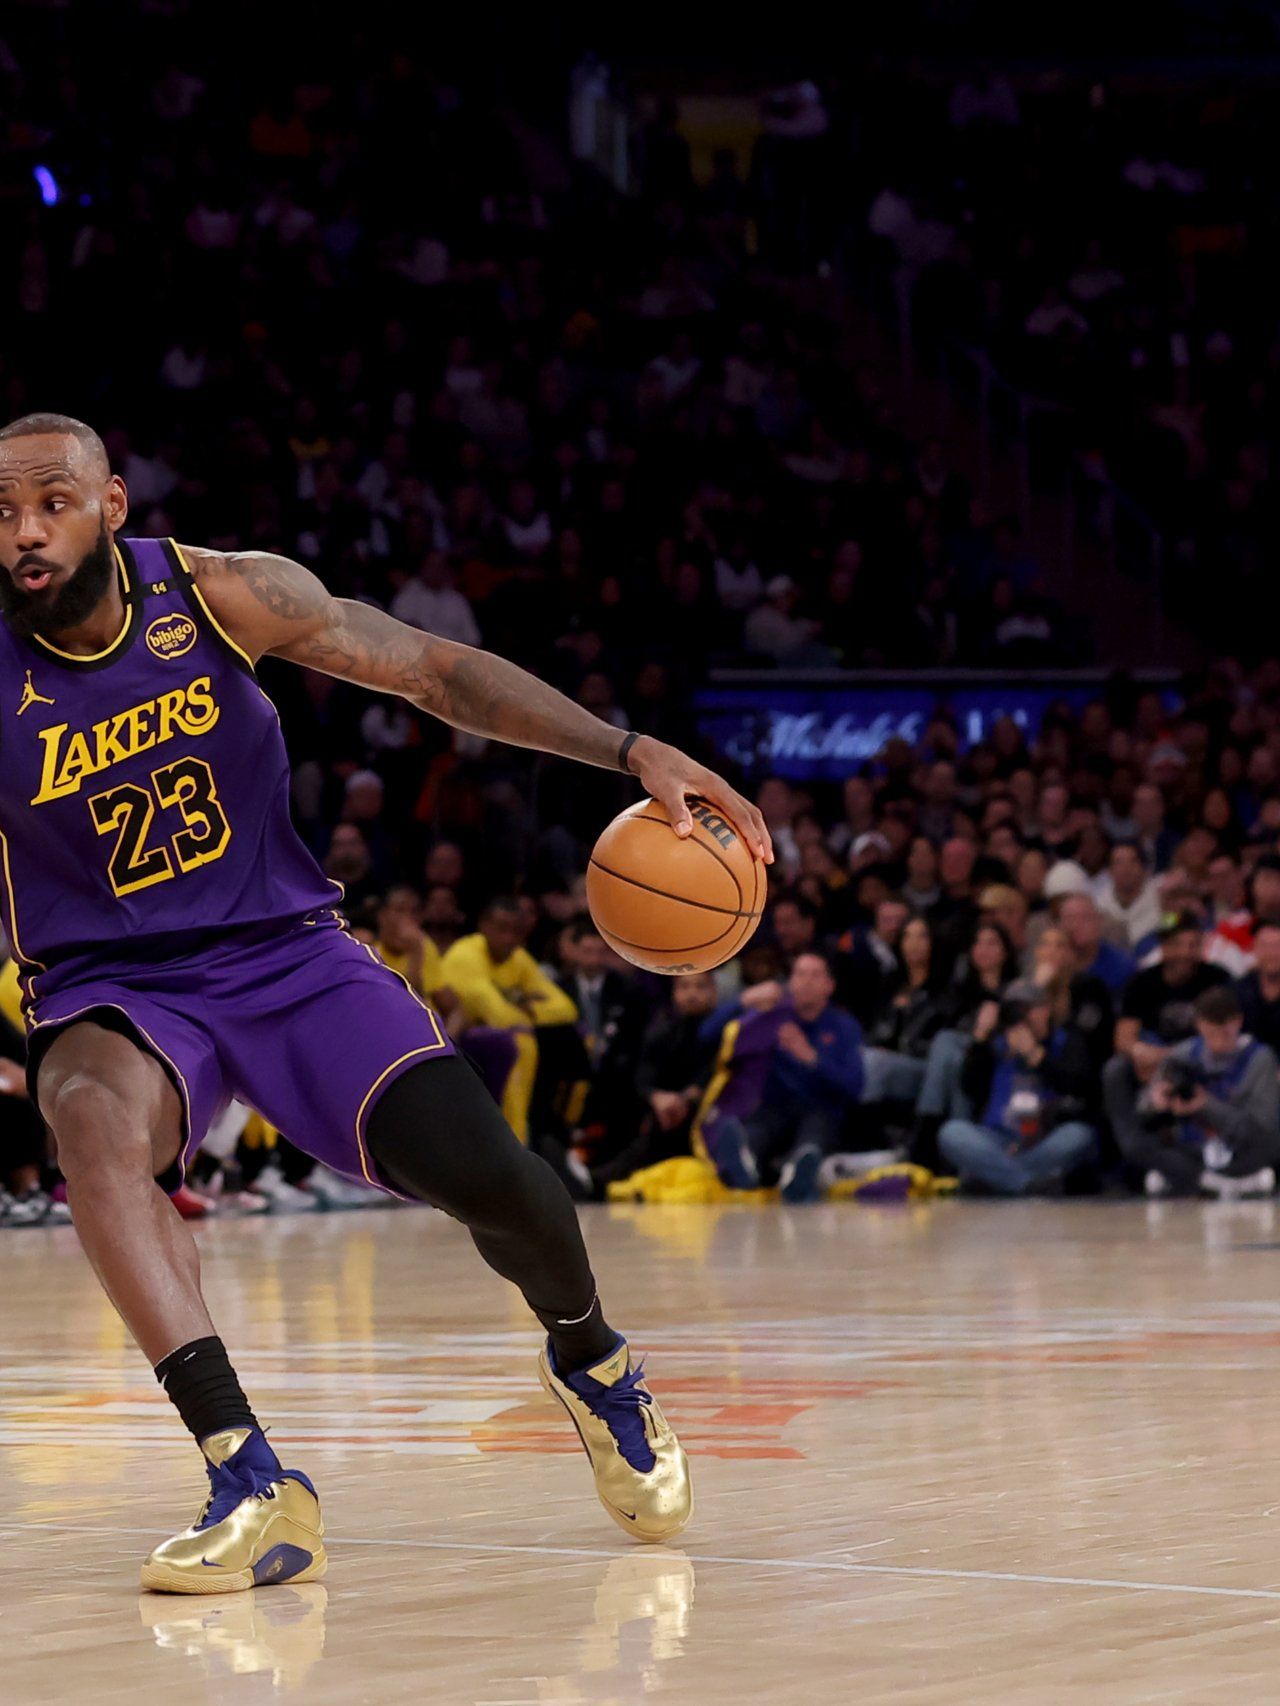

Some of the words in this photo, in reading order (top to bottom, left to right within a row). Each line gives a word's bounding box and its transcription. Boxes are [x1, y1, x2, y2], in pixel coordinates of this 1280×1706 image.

[152, 581, 167, 594] 44
[149, 623, 193, 648] bibigo
[30, 676, 220, 806] LAKERS
[87, 755, 232, 898] 23
